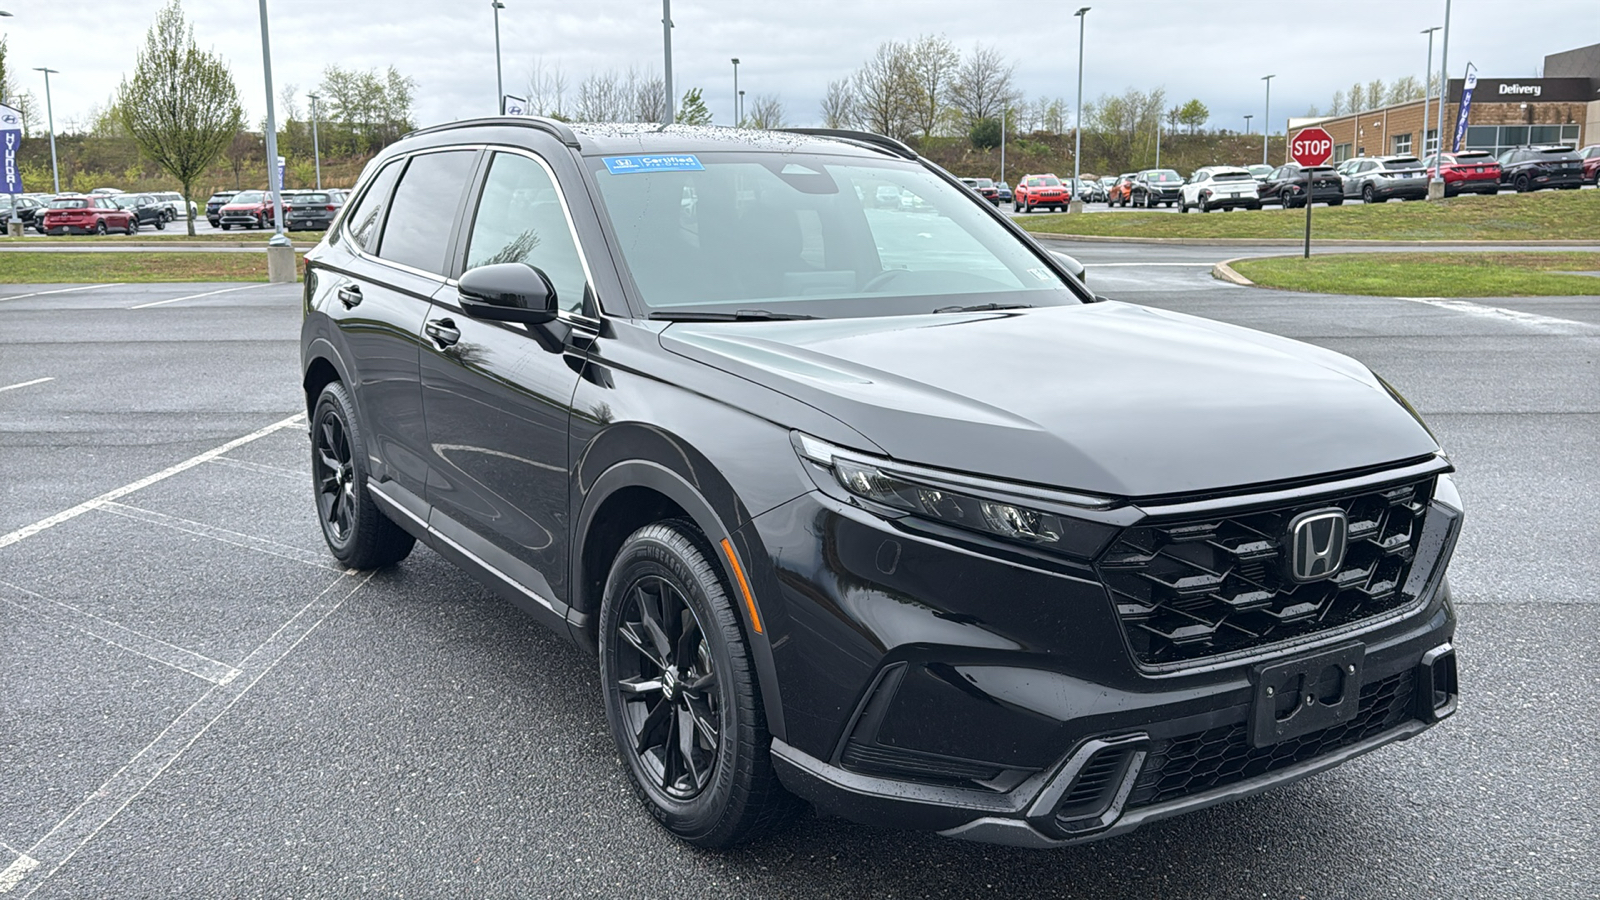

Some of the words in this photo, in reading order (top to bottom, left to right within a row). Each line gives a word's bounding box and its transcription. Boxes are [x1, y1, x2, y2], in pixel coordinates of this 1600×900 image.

[1499, 84, 1541, 96] Delivery
[1294, 140, 1330, 156] STOP
[5, 132, 15, 192] HYUNDAI
